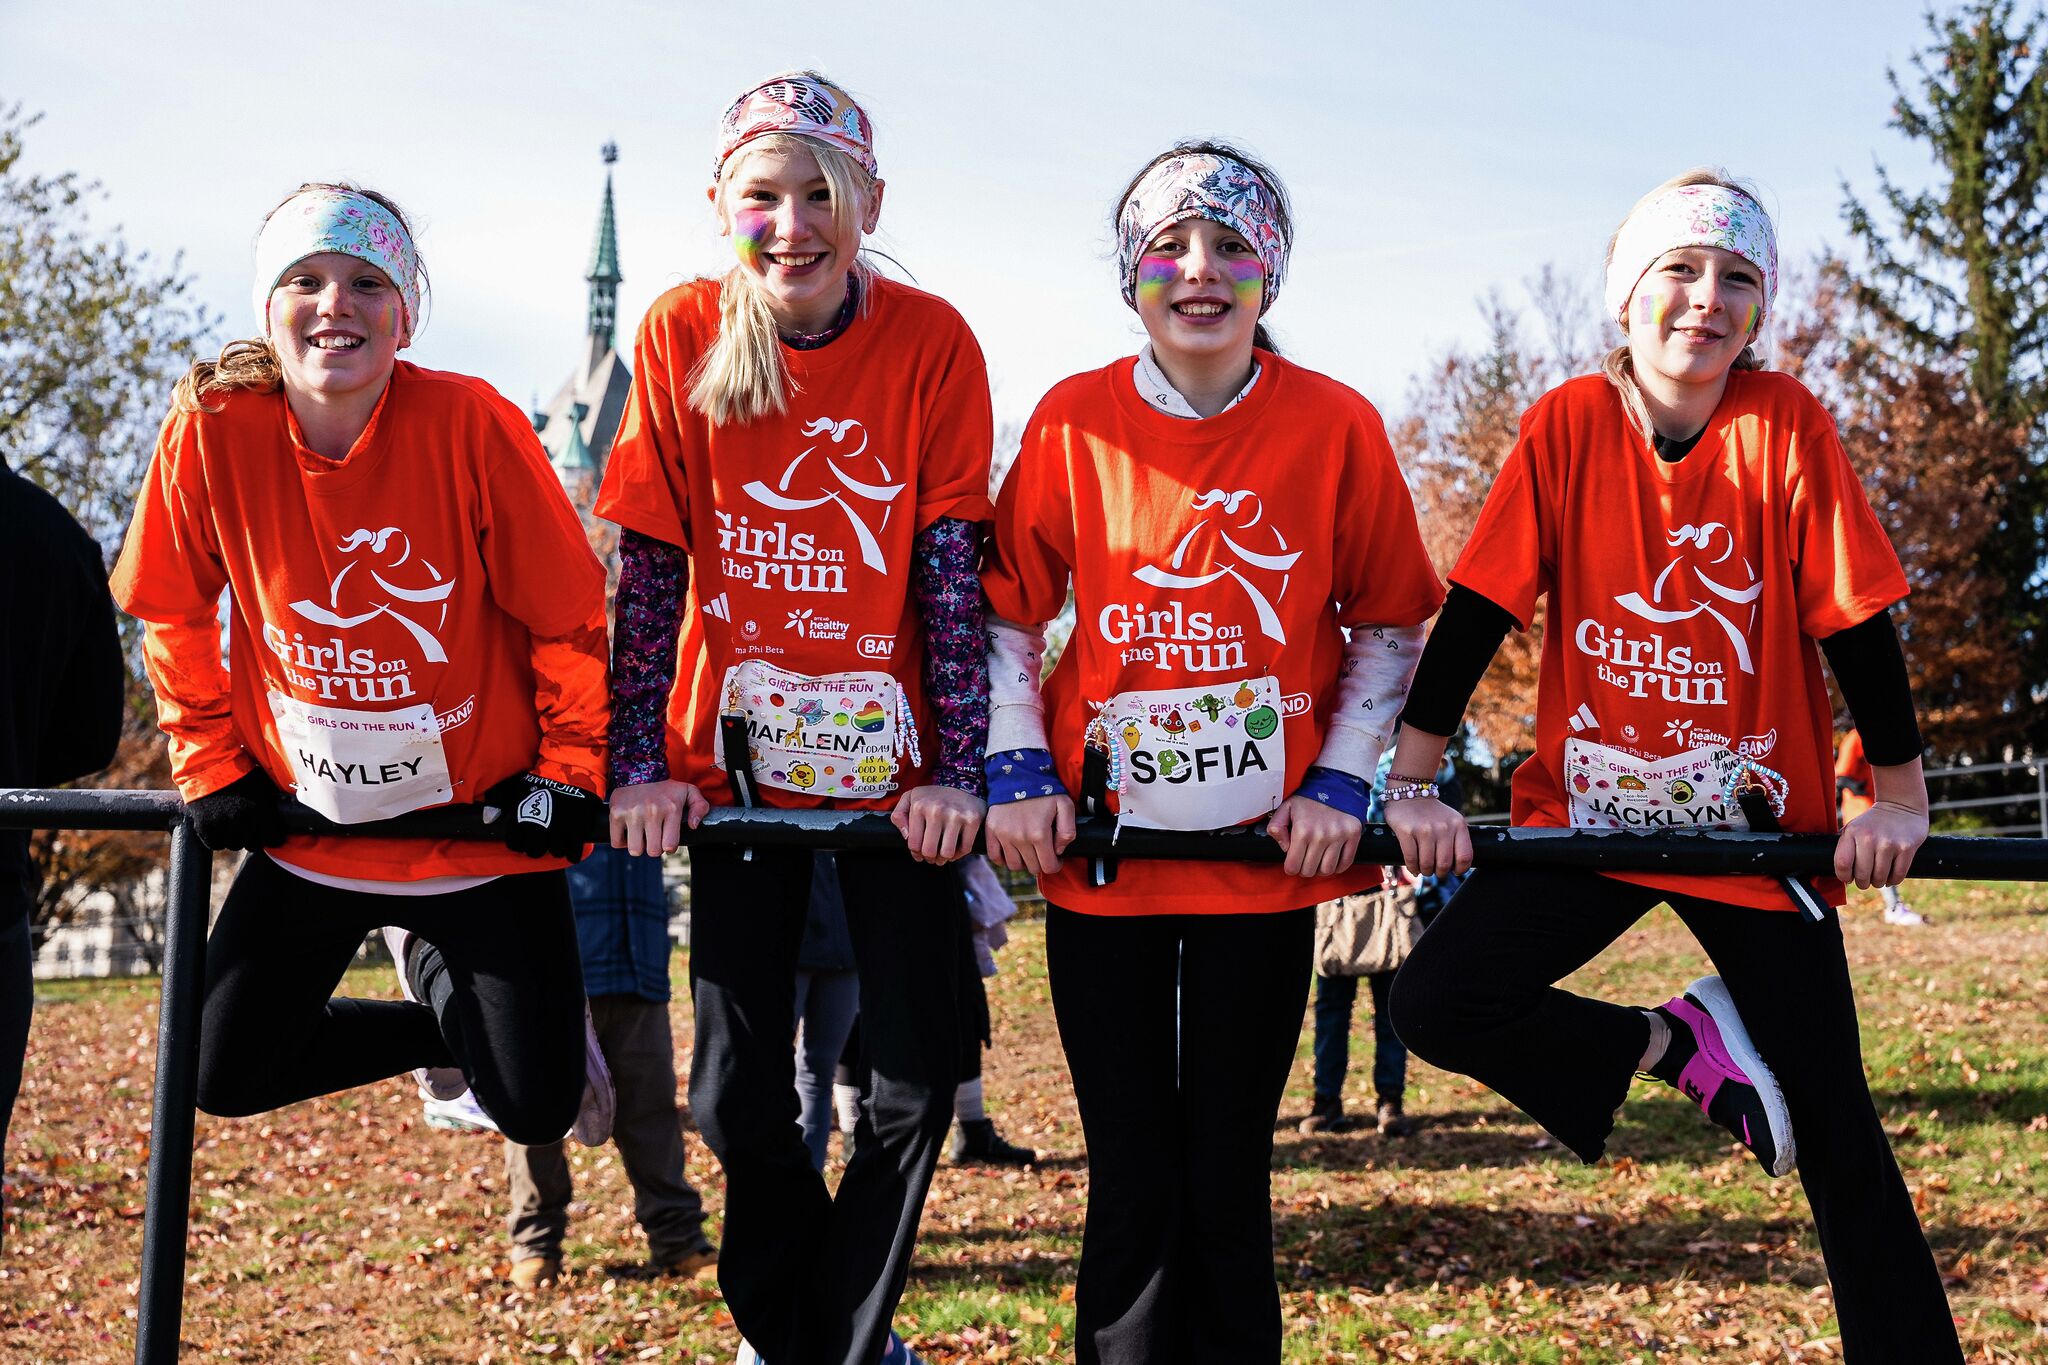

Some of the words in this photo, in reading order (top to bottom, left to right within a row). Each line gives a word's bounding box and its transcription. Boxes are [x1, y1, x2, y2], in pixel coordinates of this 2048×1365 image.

[715, 510, 815, 560] Girls
[816, 549, 844, 562] on
[721, 559, 753, 580] the
[753, 560, 848, 593] run
[810, 620, 849, 633] healthy
[1099, 601, 1212, 644] Girls
[1216, 624, 1243, 639] on
[809, 631, 846, 640] futures
[263, 621, 377, 675] Girls
[379, 656, 407, 674] on
[749, 646, 763, 654] Phi
[765, 646, 785, 654] Beta
[865, 639, 895, 655] BAN
[1575, 618, 1693, 675] Girls
[1694, 661, 1723, 674] on
[1155, 641, 1247, 672] run
[284, 666, 317, 690] the
[316, 670, 415, 701] run
[768, 677, 797, 692] GIRLS
[801, 684, 820, 692] ON
[824, 684, 845, 692] THE
[849, 684, 874, 692] RUN
[1597, 663, 1629, 689] the
[1629, 670, 1728, 705] run
[1281, 697, 1305, 714] ND
[307, 715, 337, 729] GIRLS
[340, 721, 359, 731] ON
[364, 723, 385, 732] THE
[389, 721, 415, 731] RUN
[1690, 731, 1731, 746] healthy
[860, 745, 890, 753] TODAY
[299, 749, 423, 785] HAYLEY
[852, 766, 876, 774] GOOD
[879, 765, 898, 774] DAY
[1130, 740, 1268, 784] SOFIA
[861, 776, 878, 784] FOR
[1666, 766, 1688, 777] THE
[1589, 798, 1726, 826] JACKLYN
